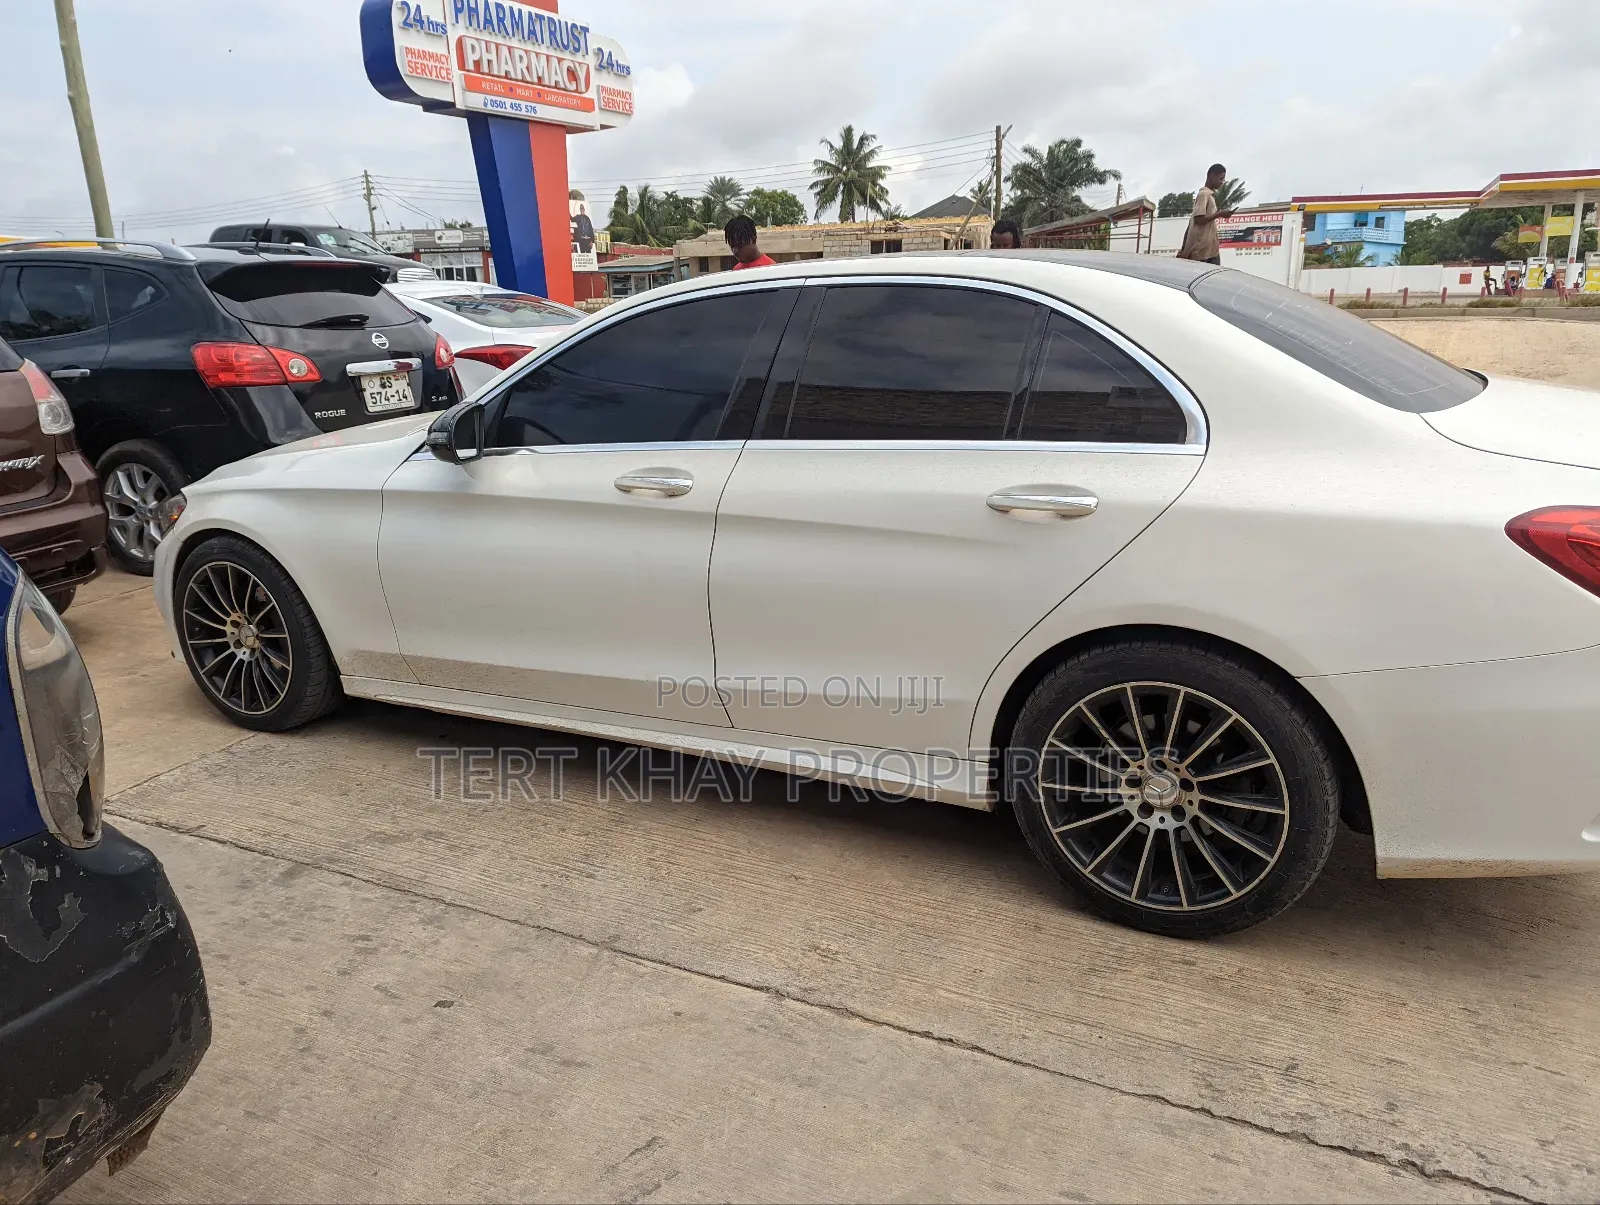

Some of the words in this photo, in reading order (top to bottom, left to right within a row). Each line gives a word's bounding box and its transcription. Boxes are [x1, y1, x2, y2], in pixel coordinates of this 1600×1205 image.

[399, 0, 424, 31] 24
[426, 15, 448, 35] hrs
[452, 0, 590, 56] PHARMATRUST
[404, 46, 450, 66] PHARMACY
[464, 36, 589, 94] PHARMACY
[596, 47, 614, 71] 24
[615, 60, 631, 76] hrs
[407, 60, 452, 81] SERVICE
[481, 81, 505, 93] RETAIL
[516, 88, 533, 98] MART
[544, 94, 581, 106] LABORATORY
[600, 86, 632, 101] PHARMACY
[489, 99, 507, 110] 0501
[509, 102, 522, 112] 455
[525, 104, 538, 115] 576
[602, 99, 634, 113] SERVICE
[369, 388, 408, 404] 574-14
[314, 409, 347, 419] ROGUE
